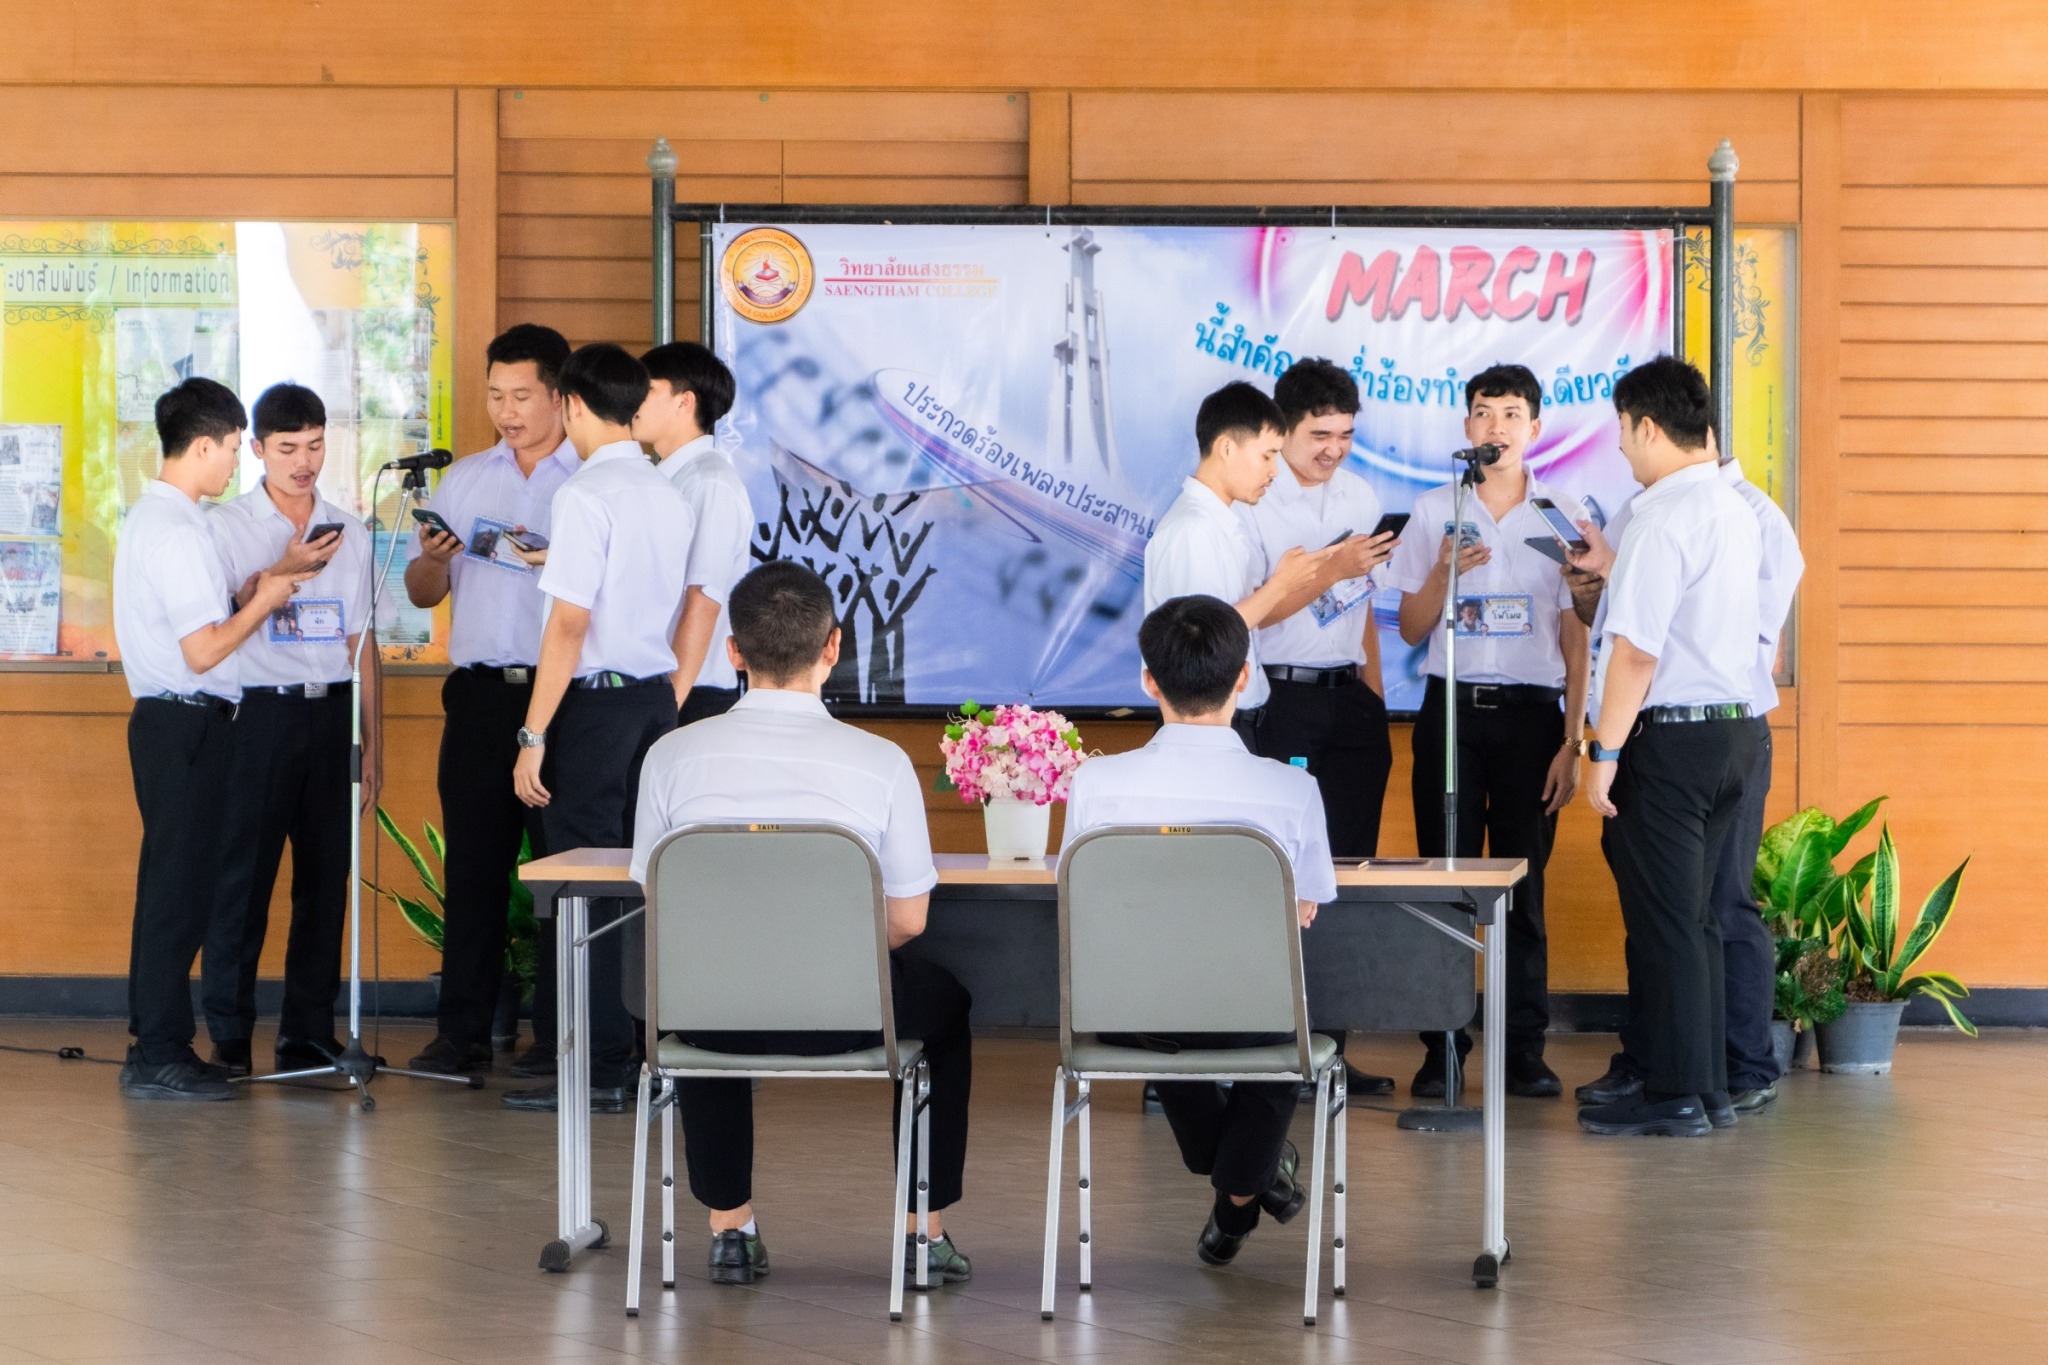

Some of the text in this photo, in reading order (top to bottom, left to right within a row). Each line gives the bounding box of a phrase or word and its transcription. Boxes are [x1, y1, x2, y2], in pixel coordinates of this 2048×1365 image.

[0, 261, 99, 292] ะชาสัมพันธ์
[126, 265, 229, 299] Information
[839, 256, 985, 278] วิทยาลัยแสงธรรม
[824, 285, 998, 297] SAENGTHAM COLLEGE
[1326, 244, 1596, 327] MARCH
[903, 382, 1154, 539] ประกวดร้องเพลงประสานเ
[758, 823, 780, 831] TAIYO
